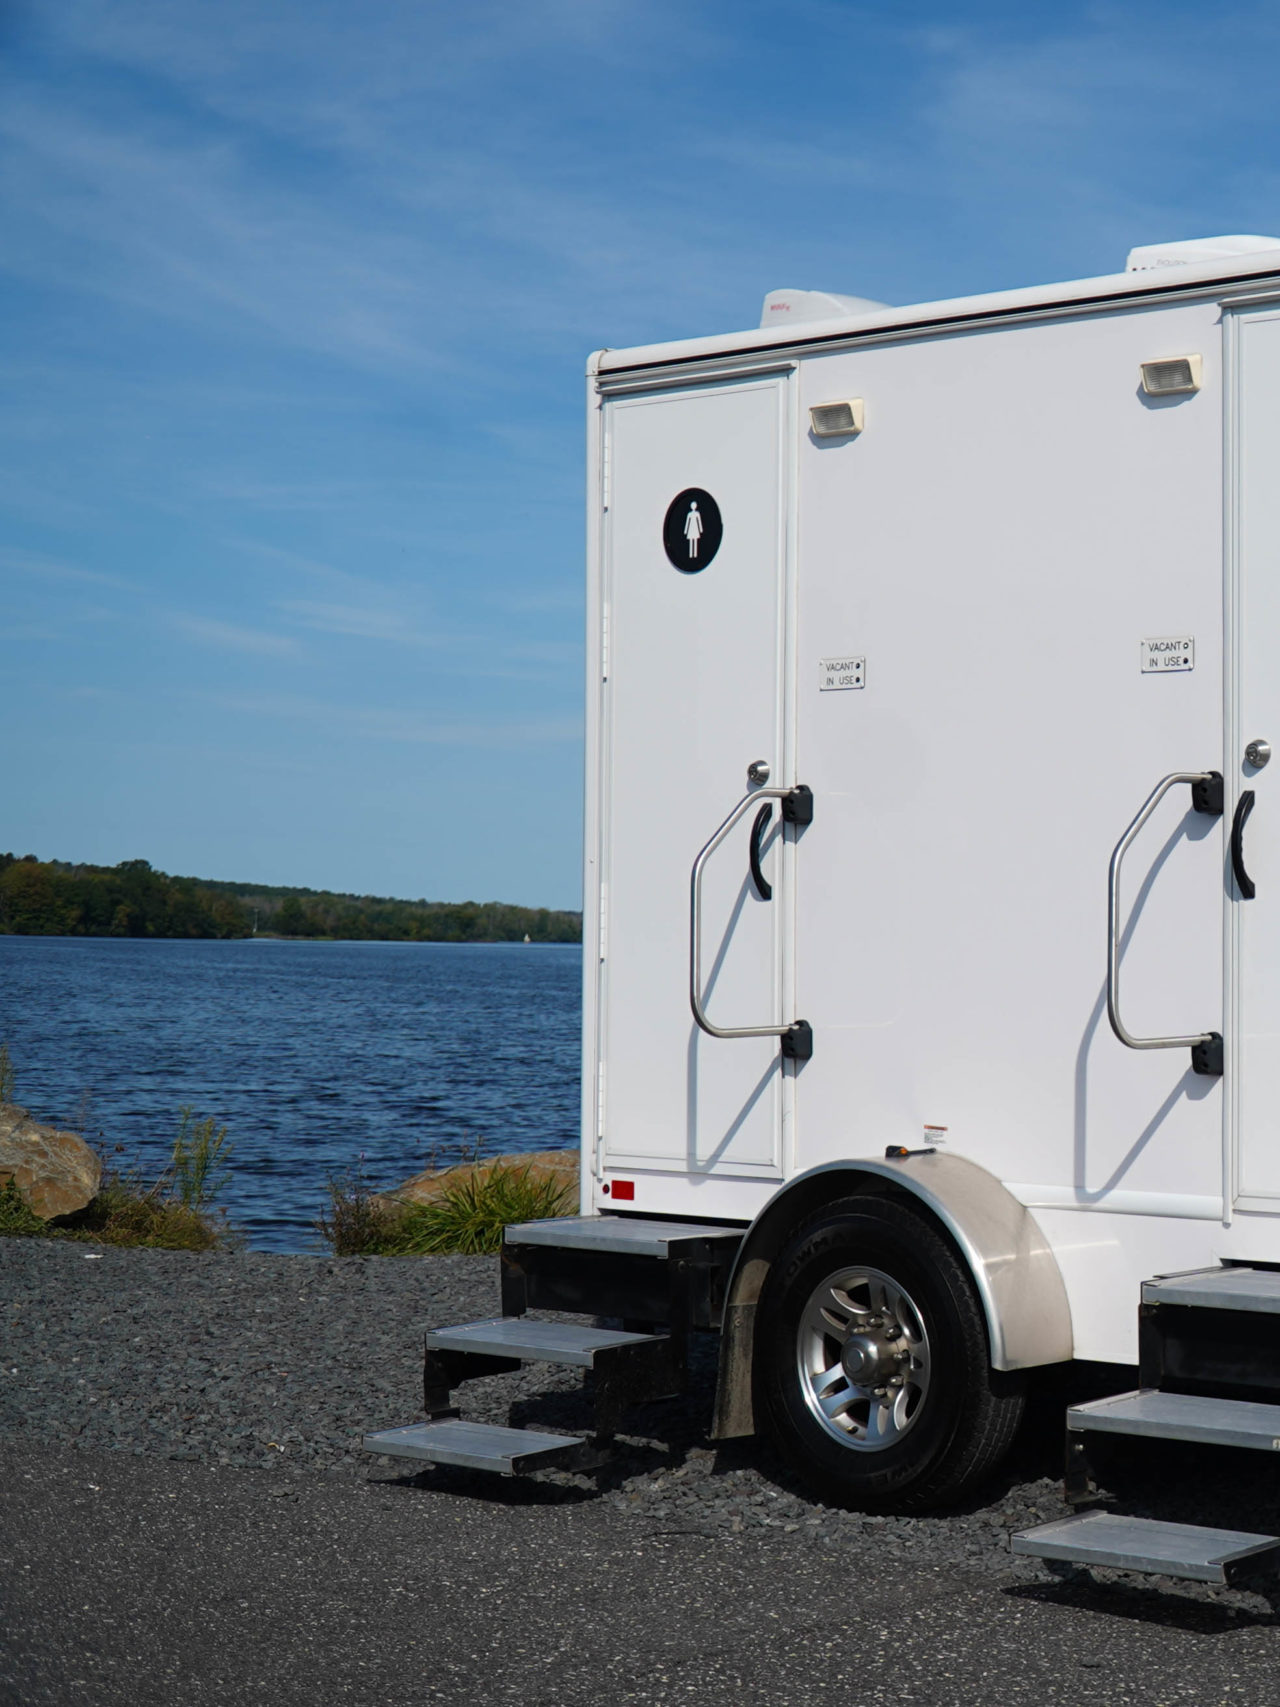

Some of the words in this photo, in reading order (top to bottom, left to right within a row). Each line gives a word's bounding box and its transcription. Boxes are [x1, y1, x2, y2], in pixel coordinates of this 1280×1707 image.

[1148, 641, 1182, 652] VACANT
[825, 661, 854, 672] VACANT
[1149, 658, 1158, 668] IN
[1164, 656, 1182, 666] USE
[826, 677, 834, 686] IN
[839, 675, 854, 685] USE
